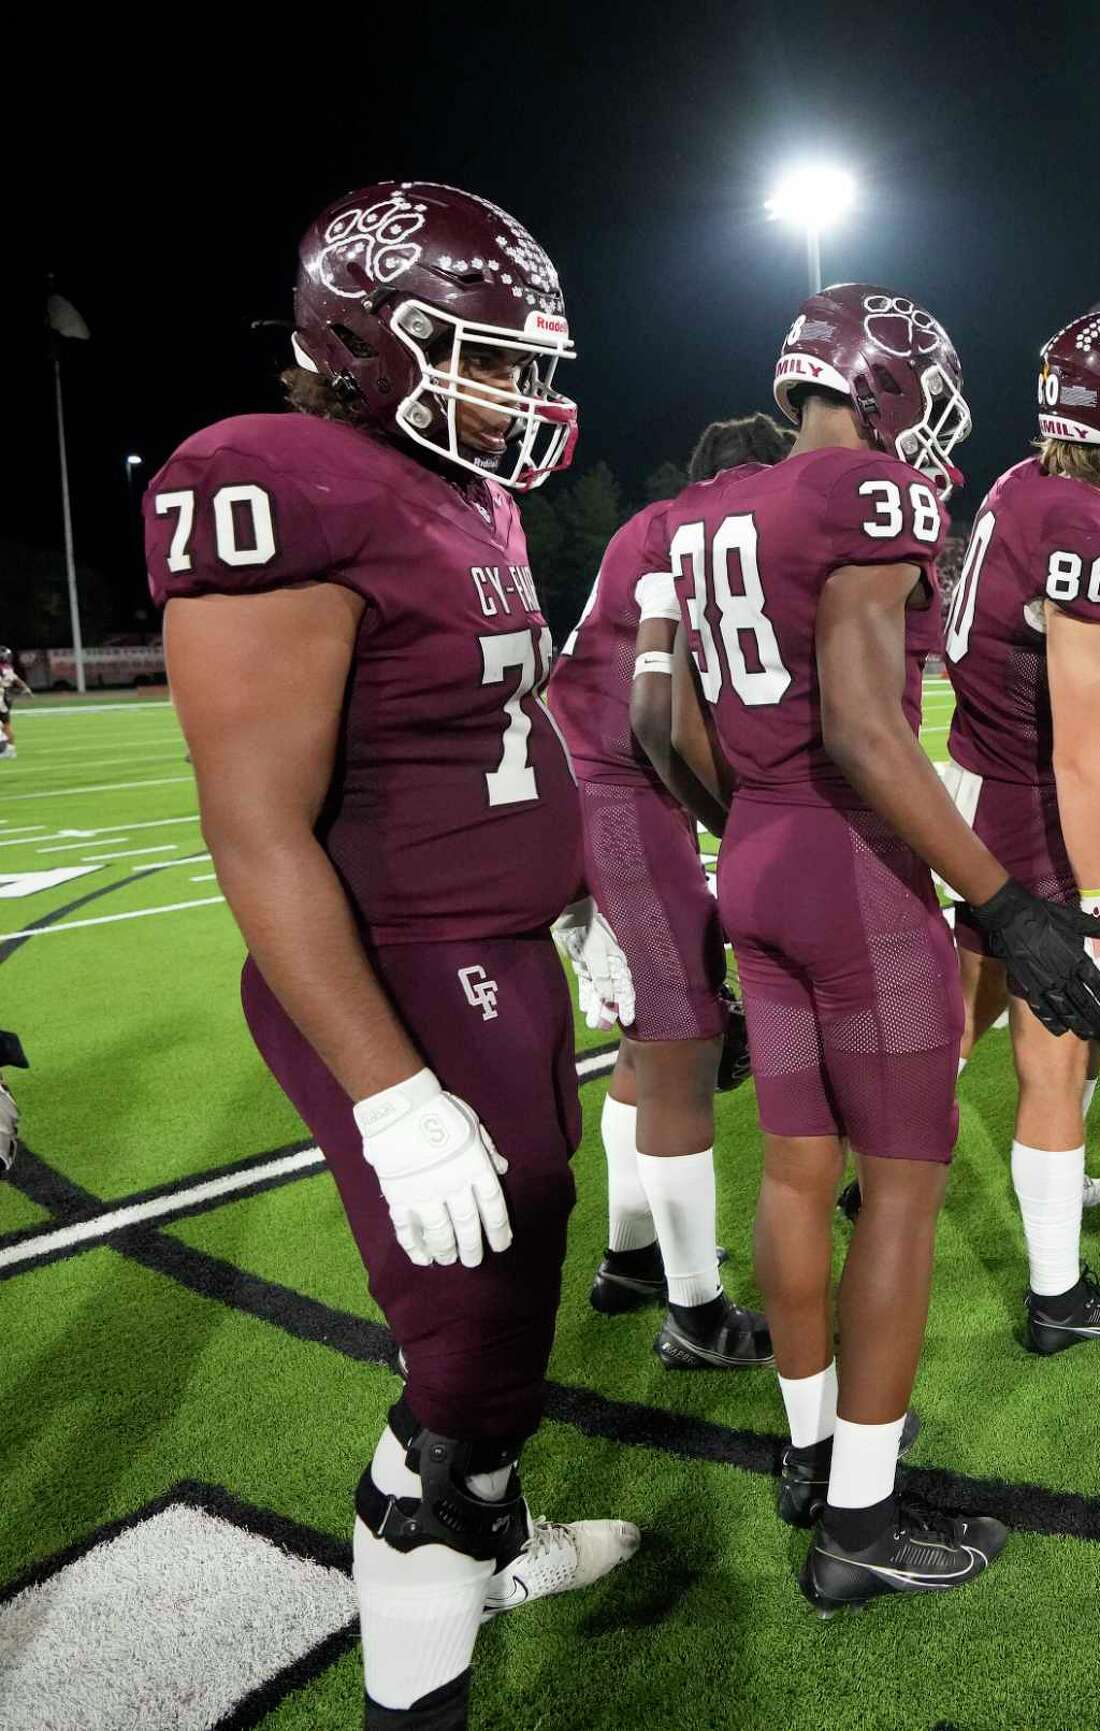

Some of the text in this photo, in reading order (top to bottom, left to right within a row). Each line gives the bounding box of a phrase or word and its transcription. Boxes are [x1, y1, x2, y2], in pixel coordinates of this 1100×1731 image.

[786, 314, 807, 346] 8
[155, 484, 276, 573] 70
[859, 480, 941, 543] 38
[471, 566, 541, 616] CY-F
[669, 513, 792, 706] 38
[478, 626, 553, 807] 7
